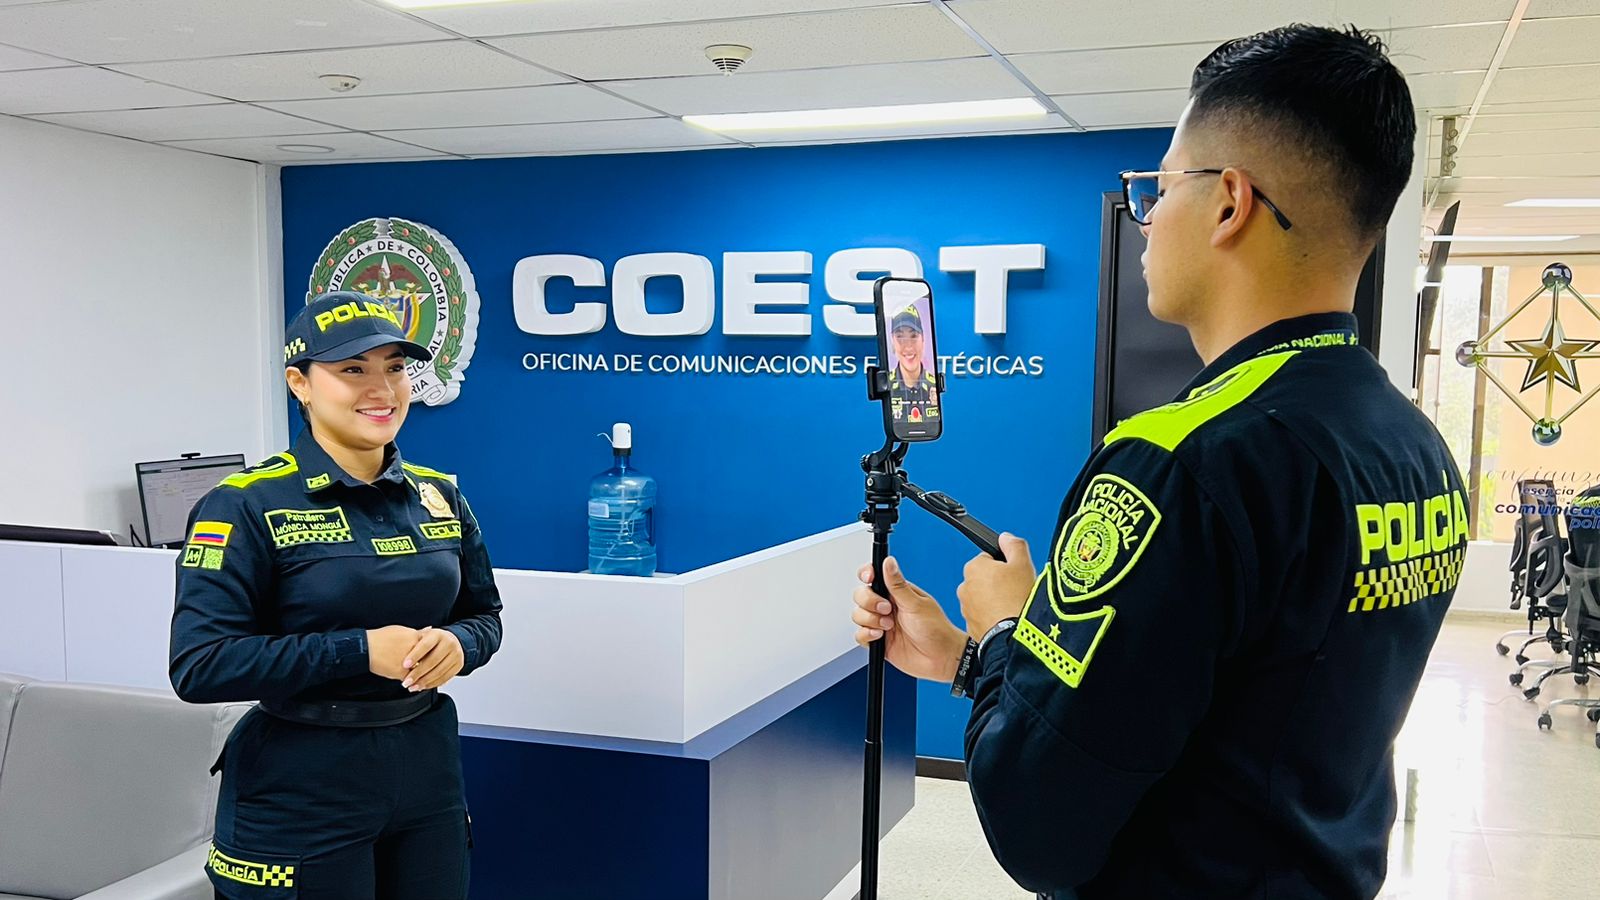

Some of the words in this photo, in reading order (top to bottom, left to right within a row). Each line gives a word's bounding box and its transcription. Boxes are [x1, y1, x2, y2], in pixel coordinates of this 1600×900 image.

[330, 248, 364, 293] UBLICA
[377, 241, 394, 251] DE
[408, 248, 447, 322] COLOMBIA
[513, 243, 1046, 337] COEST
[522, 353, 609, 372] OFICINA
[614, 354, 643, 372] DE
[648, 354, 856, 374] COMUNICACIONES
[285, 512, 325, 522] Patrullero
[1355, 470, 1470, 565] POLICÍA
[275, 522, 309, 536] MÓNICA
[214, 858, 259, 881] POLICÍA
